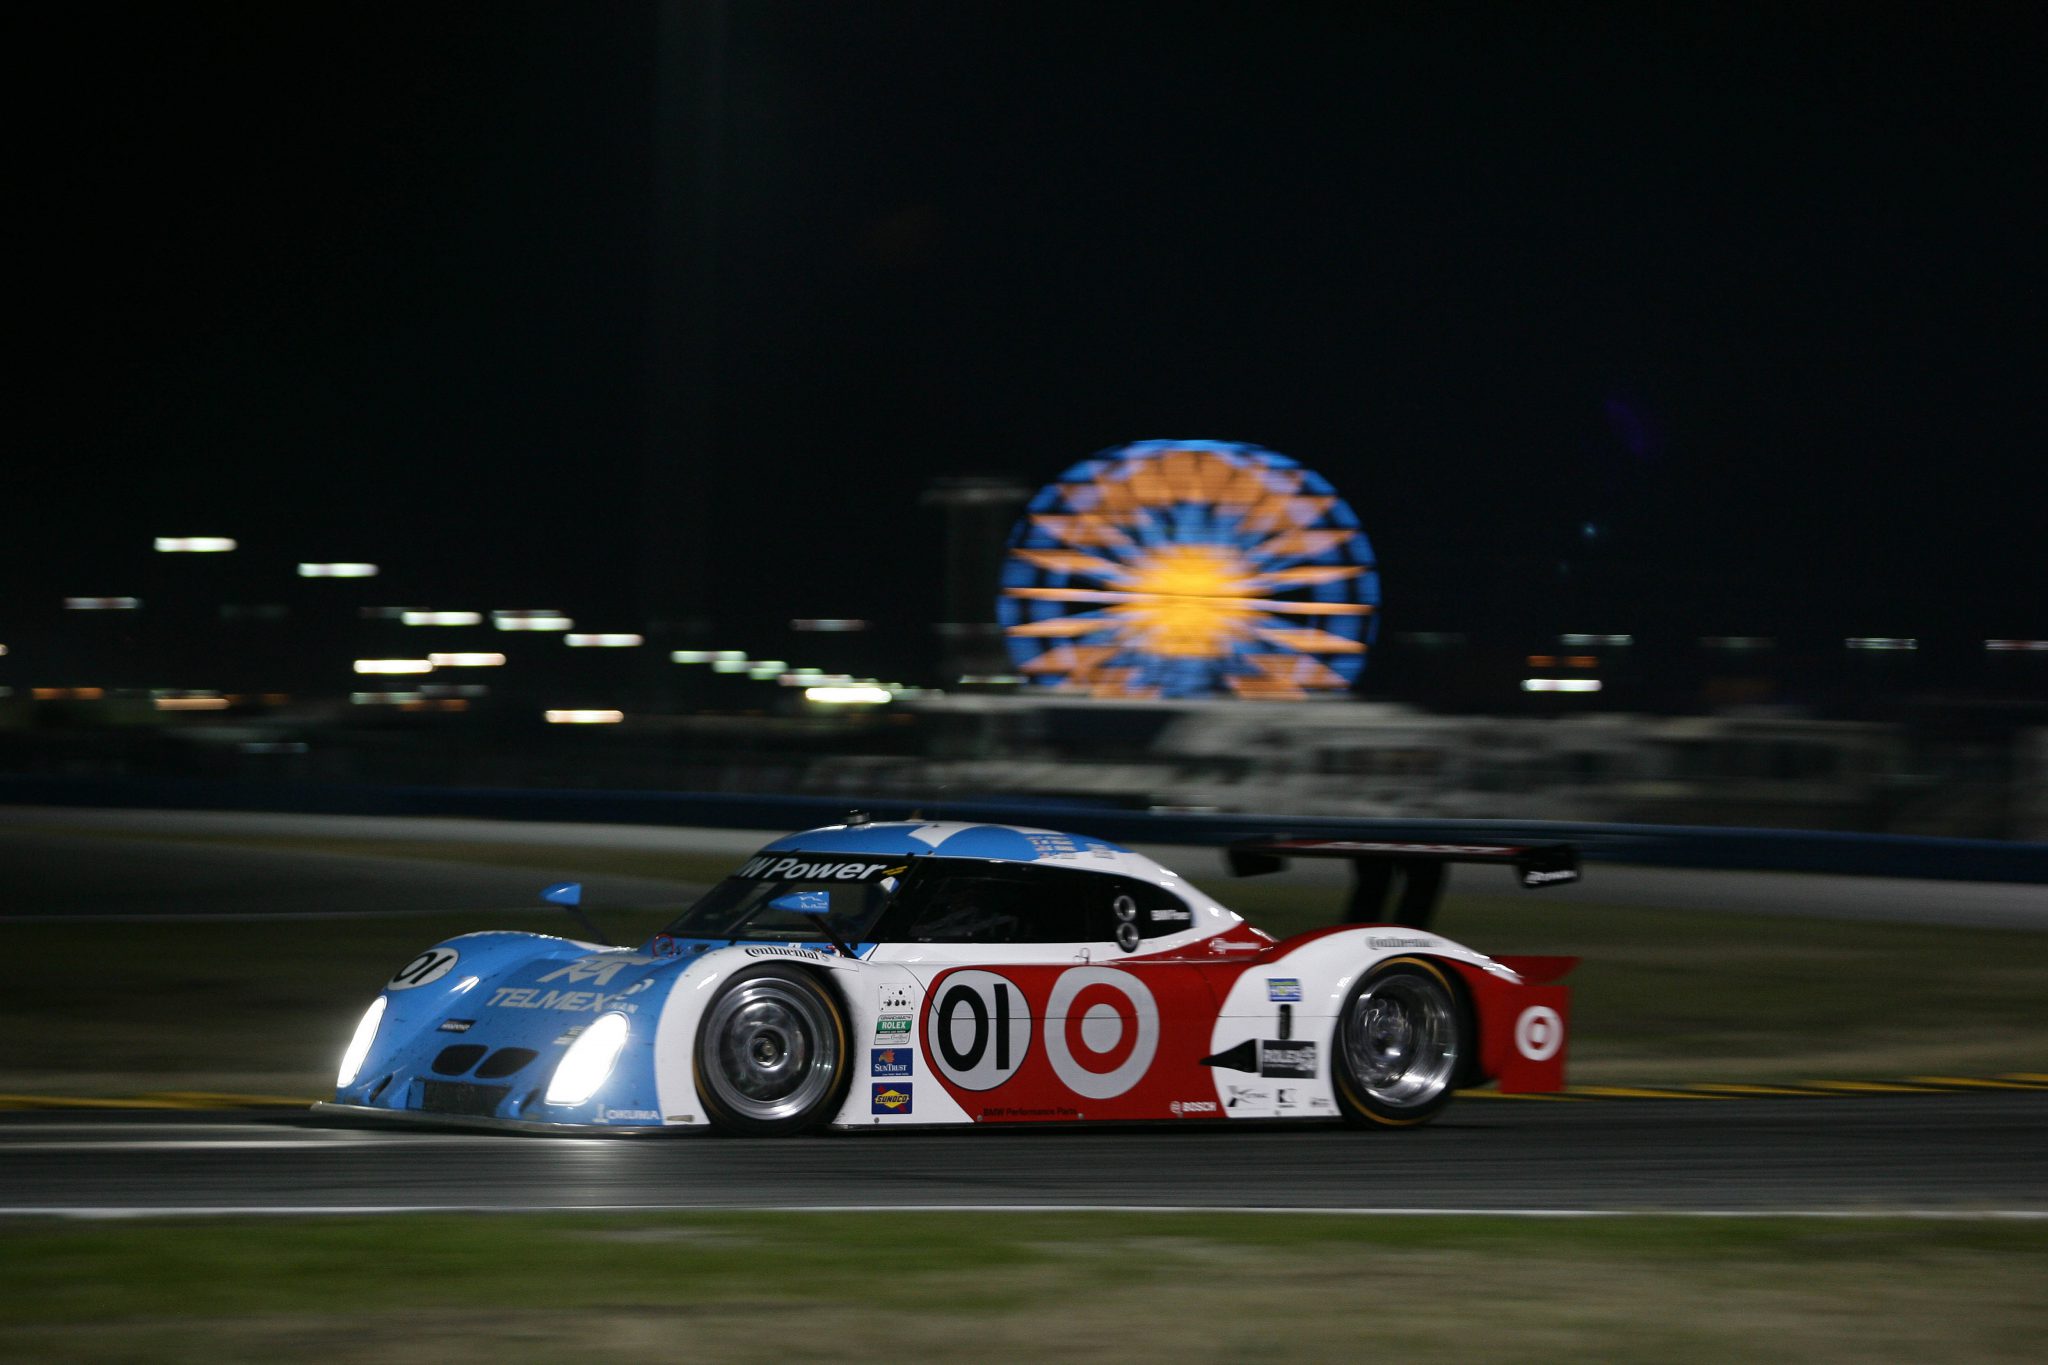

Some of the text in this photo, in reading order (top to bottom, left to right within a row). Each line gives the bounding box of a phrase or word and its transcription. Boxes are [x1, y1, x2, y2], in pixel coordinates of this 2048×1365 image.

[762, 857, 887, 880] Power
[744, 943, 819, 961] Continental
[392, 951, 454, 986] 01
[486, 987, 612, 1013] TELMEX
[881, 1021, 907, 1030] ROLEX
[937, 983, 1011, 1072] 01
[876, 1095, 909, 1103] SUNOCO
[1182, 1101, 1218, 1113] BOSCH
[983, 1107, 1004, 1117] BMW
[1006, 1107, 1055, 1117] Performance
